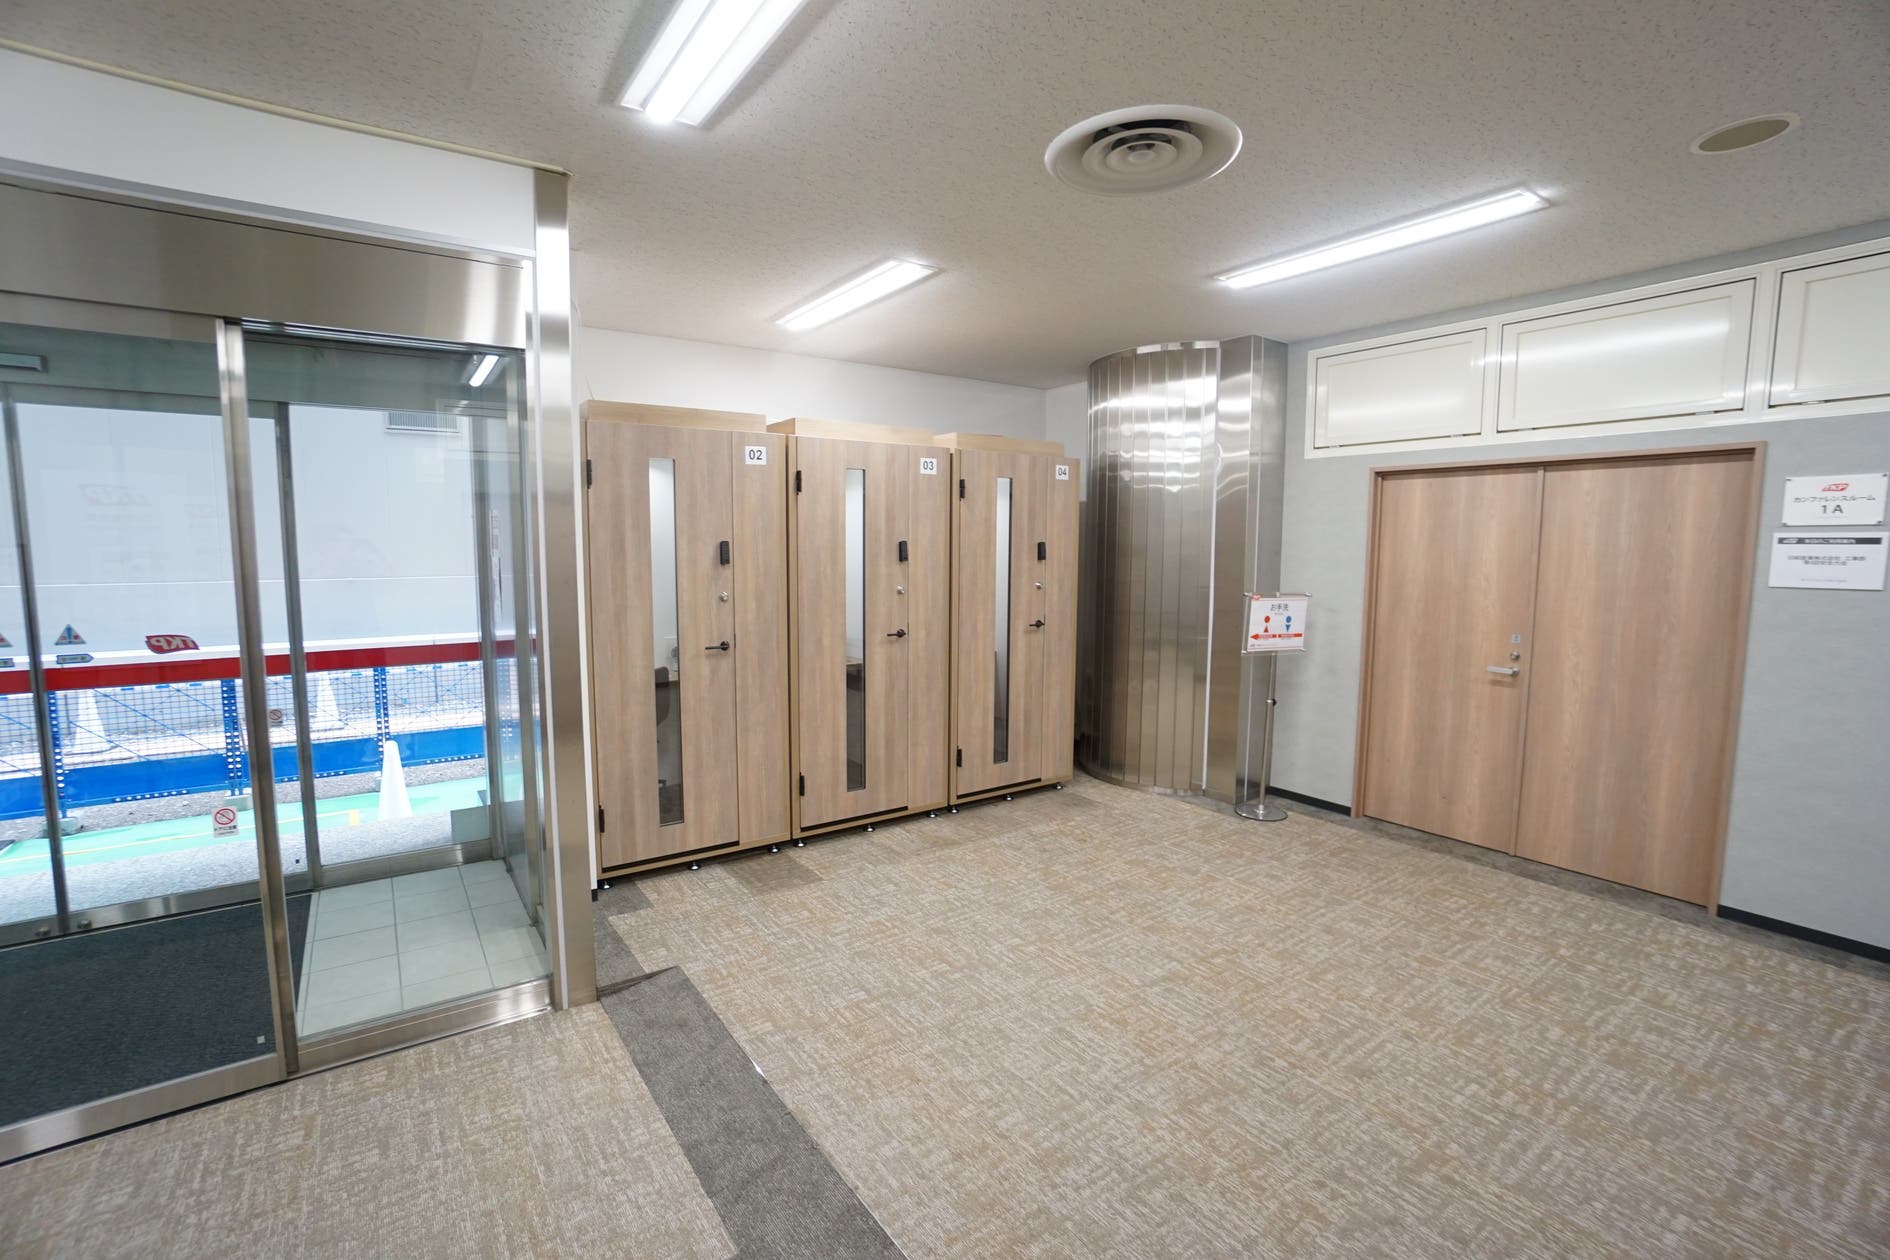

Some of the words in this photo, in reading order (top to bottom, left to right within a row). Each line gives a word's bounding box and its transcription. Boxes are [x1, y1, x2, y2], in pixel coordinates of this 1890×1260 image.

[749, 449, 763, 460] 02
[922, 460, 934, 471] 03
[1057, 467, 1067, 476] 04
